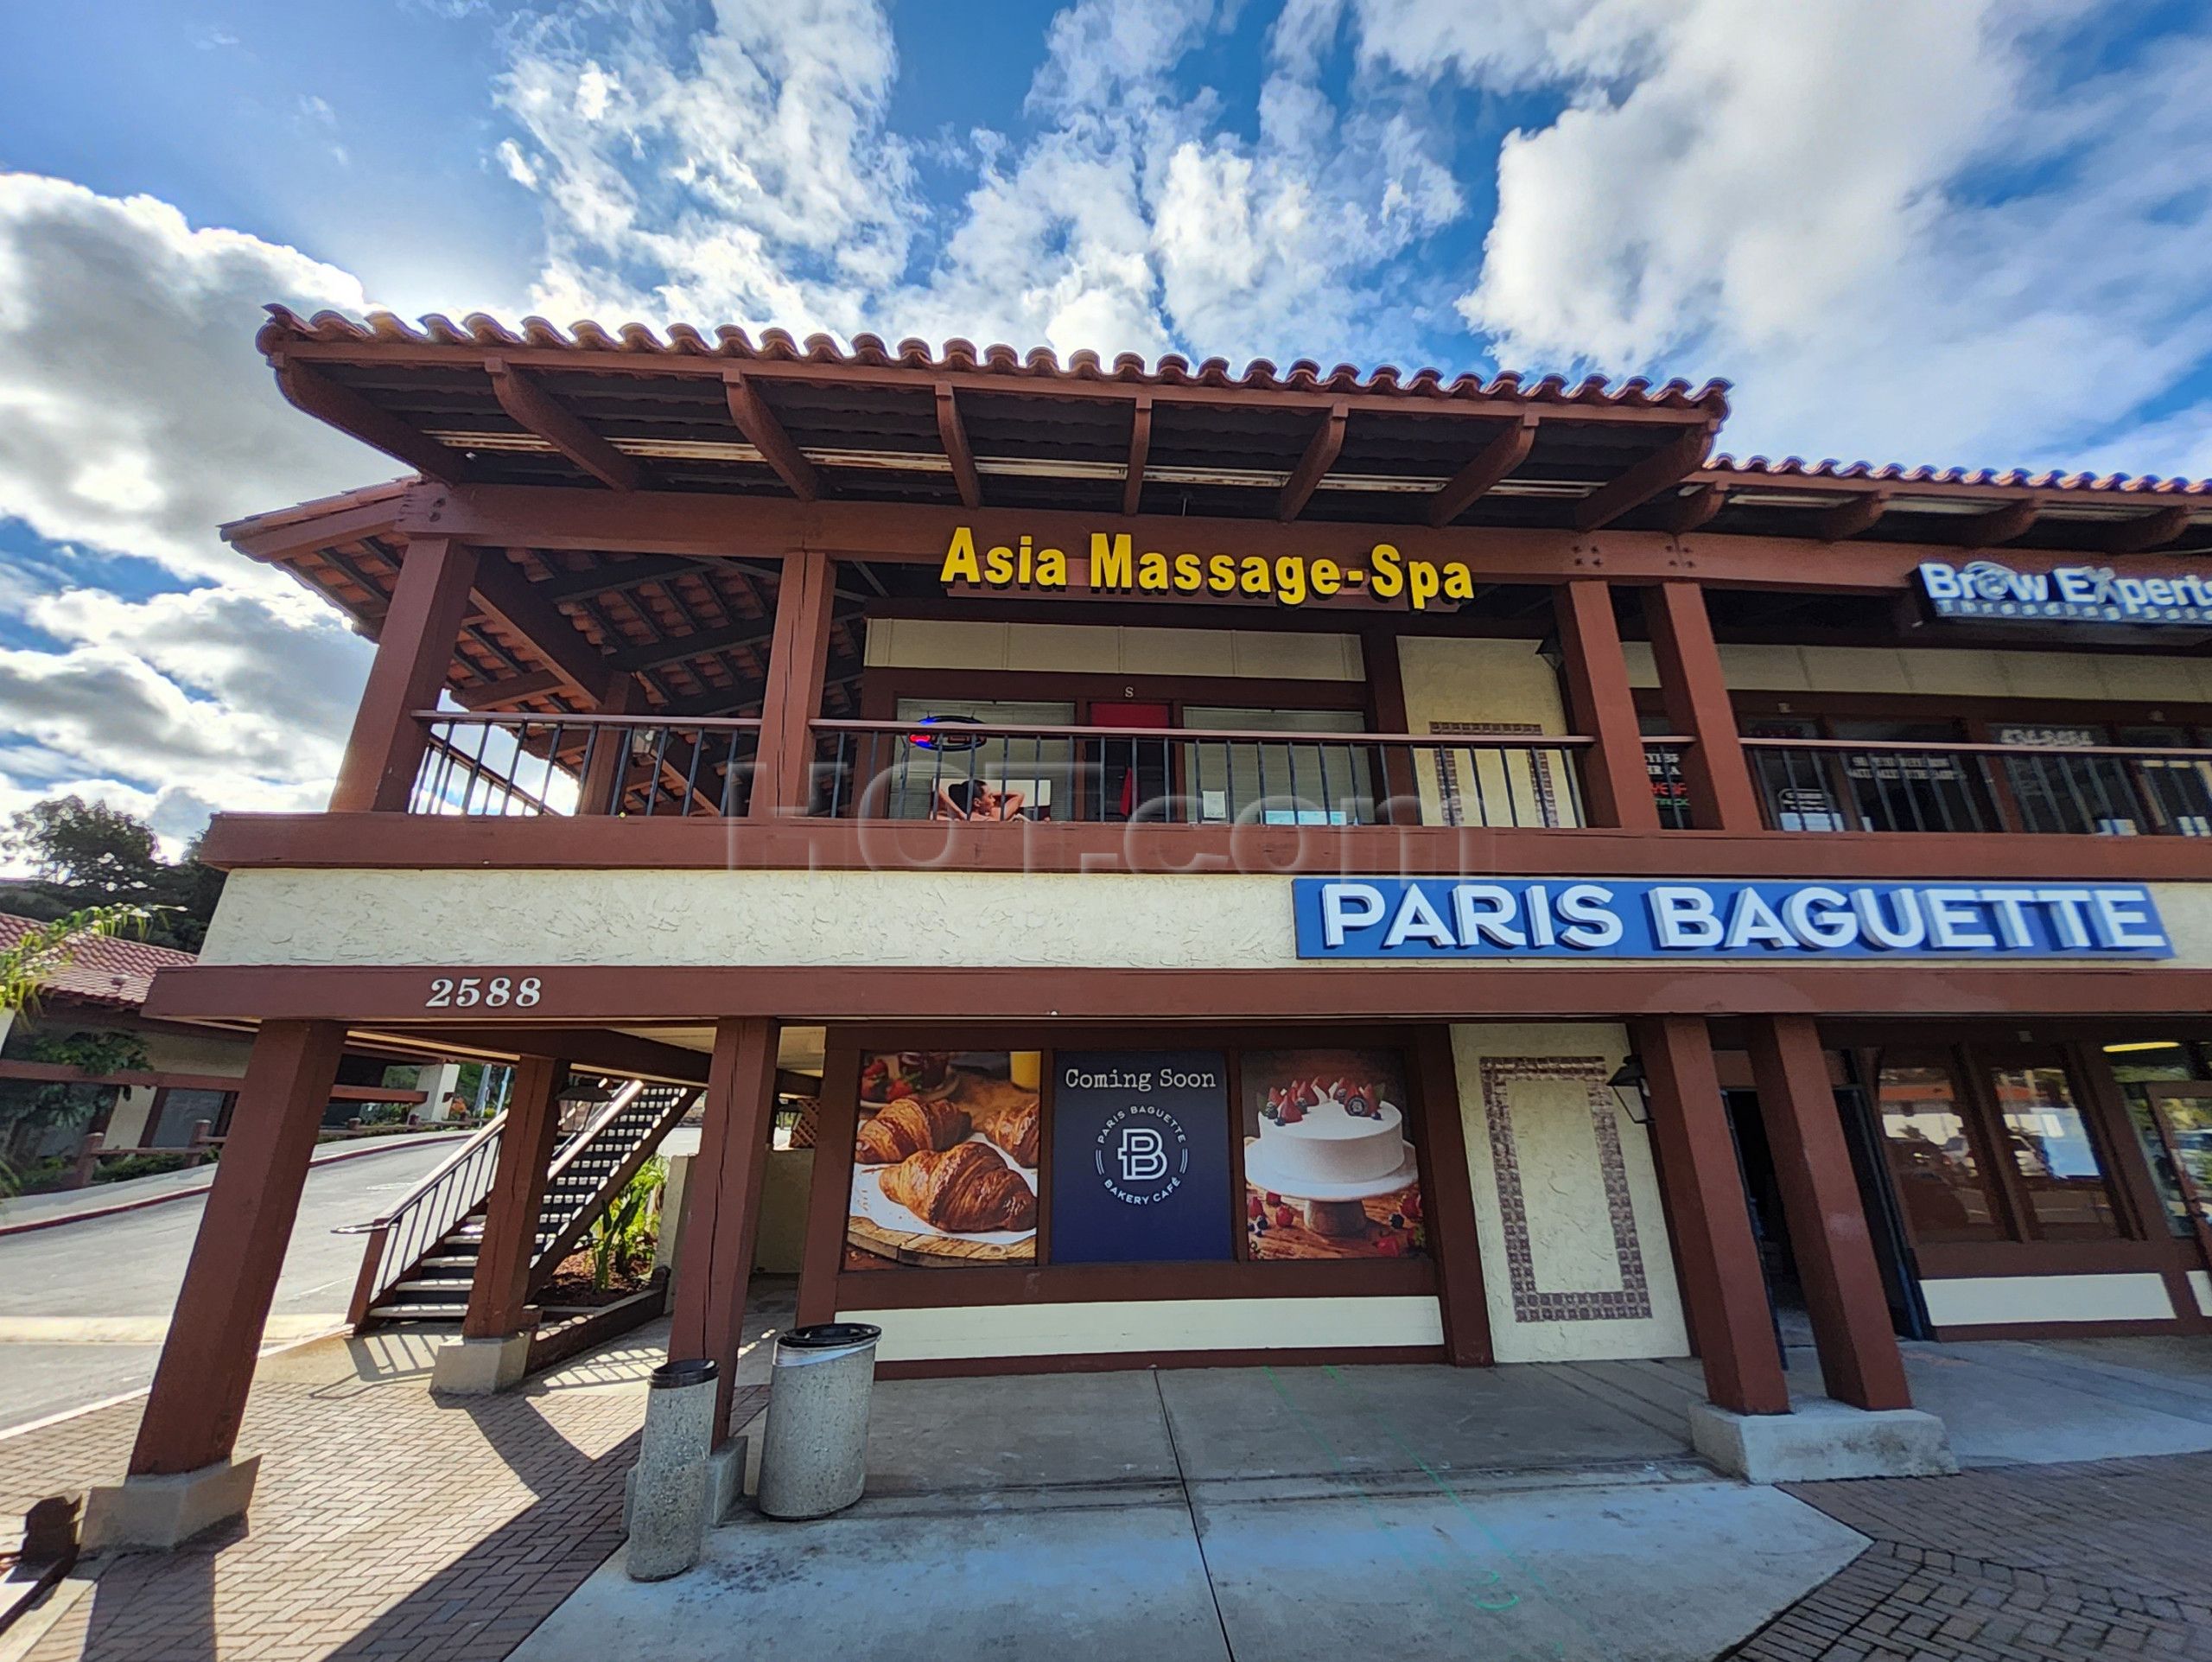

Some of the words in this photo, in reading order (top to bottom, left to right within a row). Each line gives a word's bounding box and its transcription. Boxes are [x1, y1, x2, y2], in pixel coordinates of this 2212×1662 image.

[939, 526, 1067, 586] Asia
[1090, 532, 1475, 609] Massage-Spa
[1919, 561, 2049, 602] Brow
[1125, 686, 1134, 697] S
[1322, 882, 1624, 948] PARIS
[1649, 886, 2166, 948] BAGUETTE
[425, 977, 542, 1007] 2588
[1065, 1068, 1152, 1092] Coming
[1160, 1068, 1216, 1088] Soon
[1097, 1110, 1126, 1144] PARIS
[1130, 1105, 1186, 1143] BAGUETTE
[1104, 1179, 1149, 1205] BAKERY
[1153, 1176, 1181, 1202] CAFÉ
